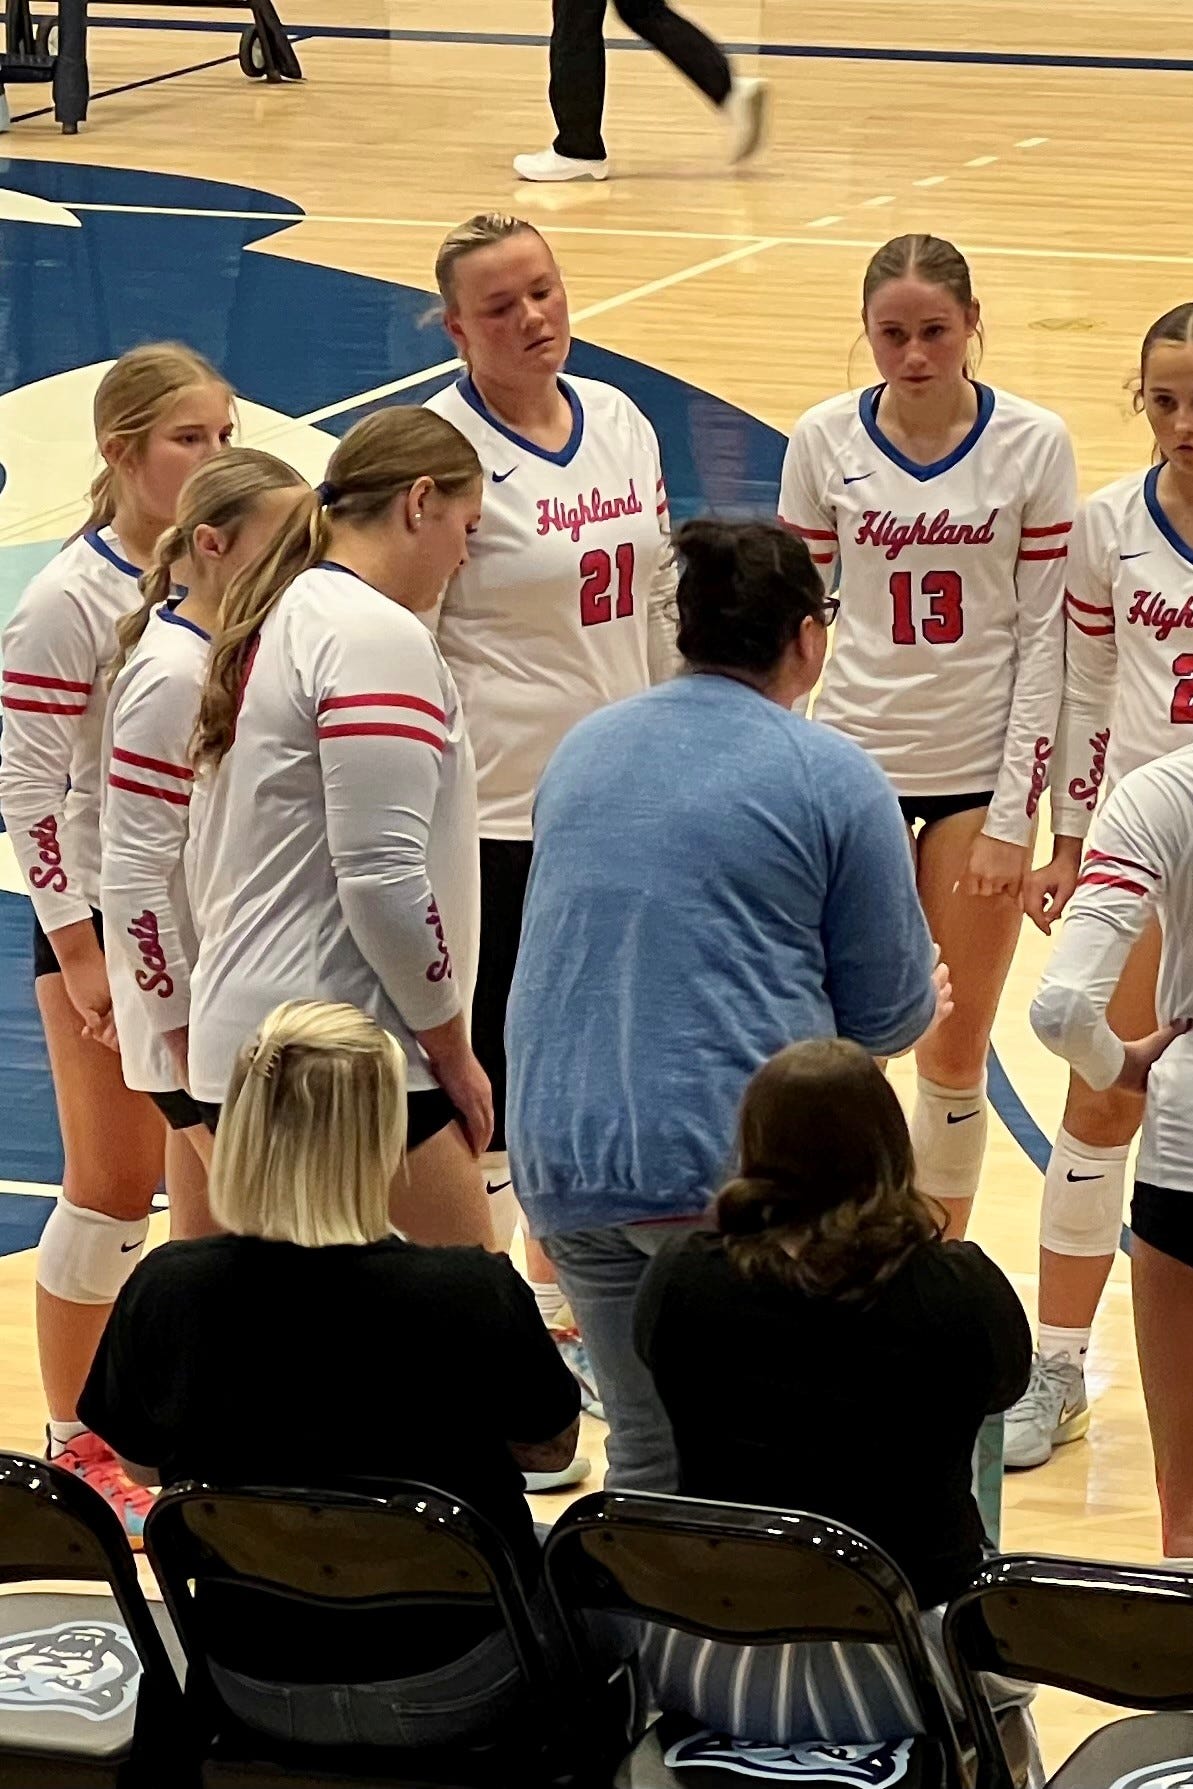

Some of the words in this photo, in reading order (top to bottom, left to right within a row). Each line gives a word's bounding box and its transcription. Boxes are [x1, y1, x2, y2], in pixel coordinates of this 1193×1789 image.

[536, 478, 643, 542] Highland
[855, 508, 1000, 560] Highland
[579, 542, 635, 627] 21
[889, 570, 964, 645] 13
